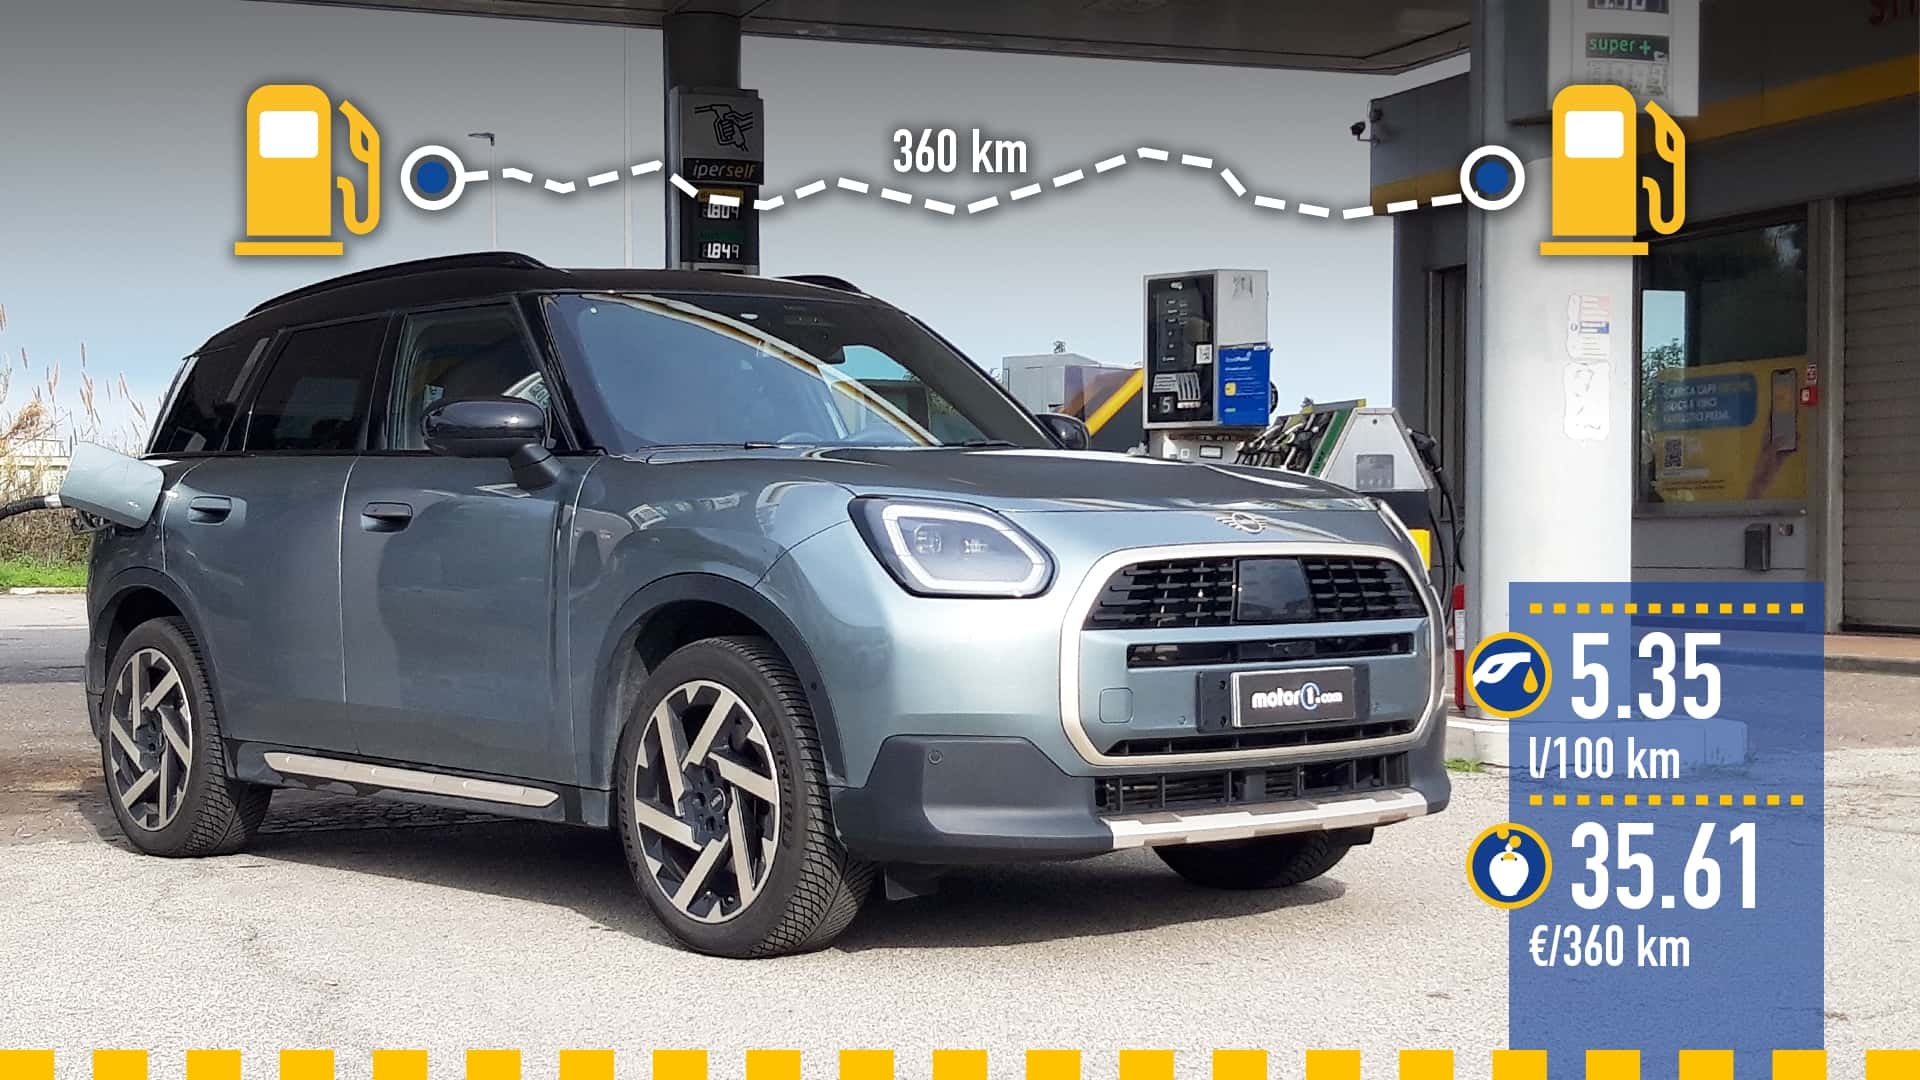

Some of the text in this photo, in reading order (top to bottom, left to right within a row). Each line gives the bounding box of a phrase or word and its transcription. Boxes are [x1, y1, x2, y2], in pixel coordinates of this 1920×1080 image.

[1589, 38, 1634, 54] super
[693, 160, 755, 179] iperself
[1252, 683, 1343, 710] motor1.com
